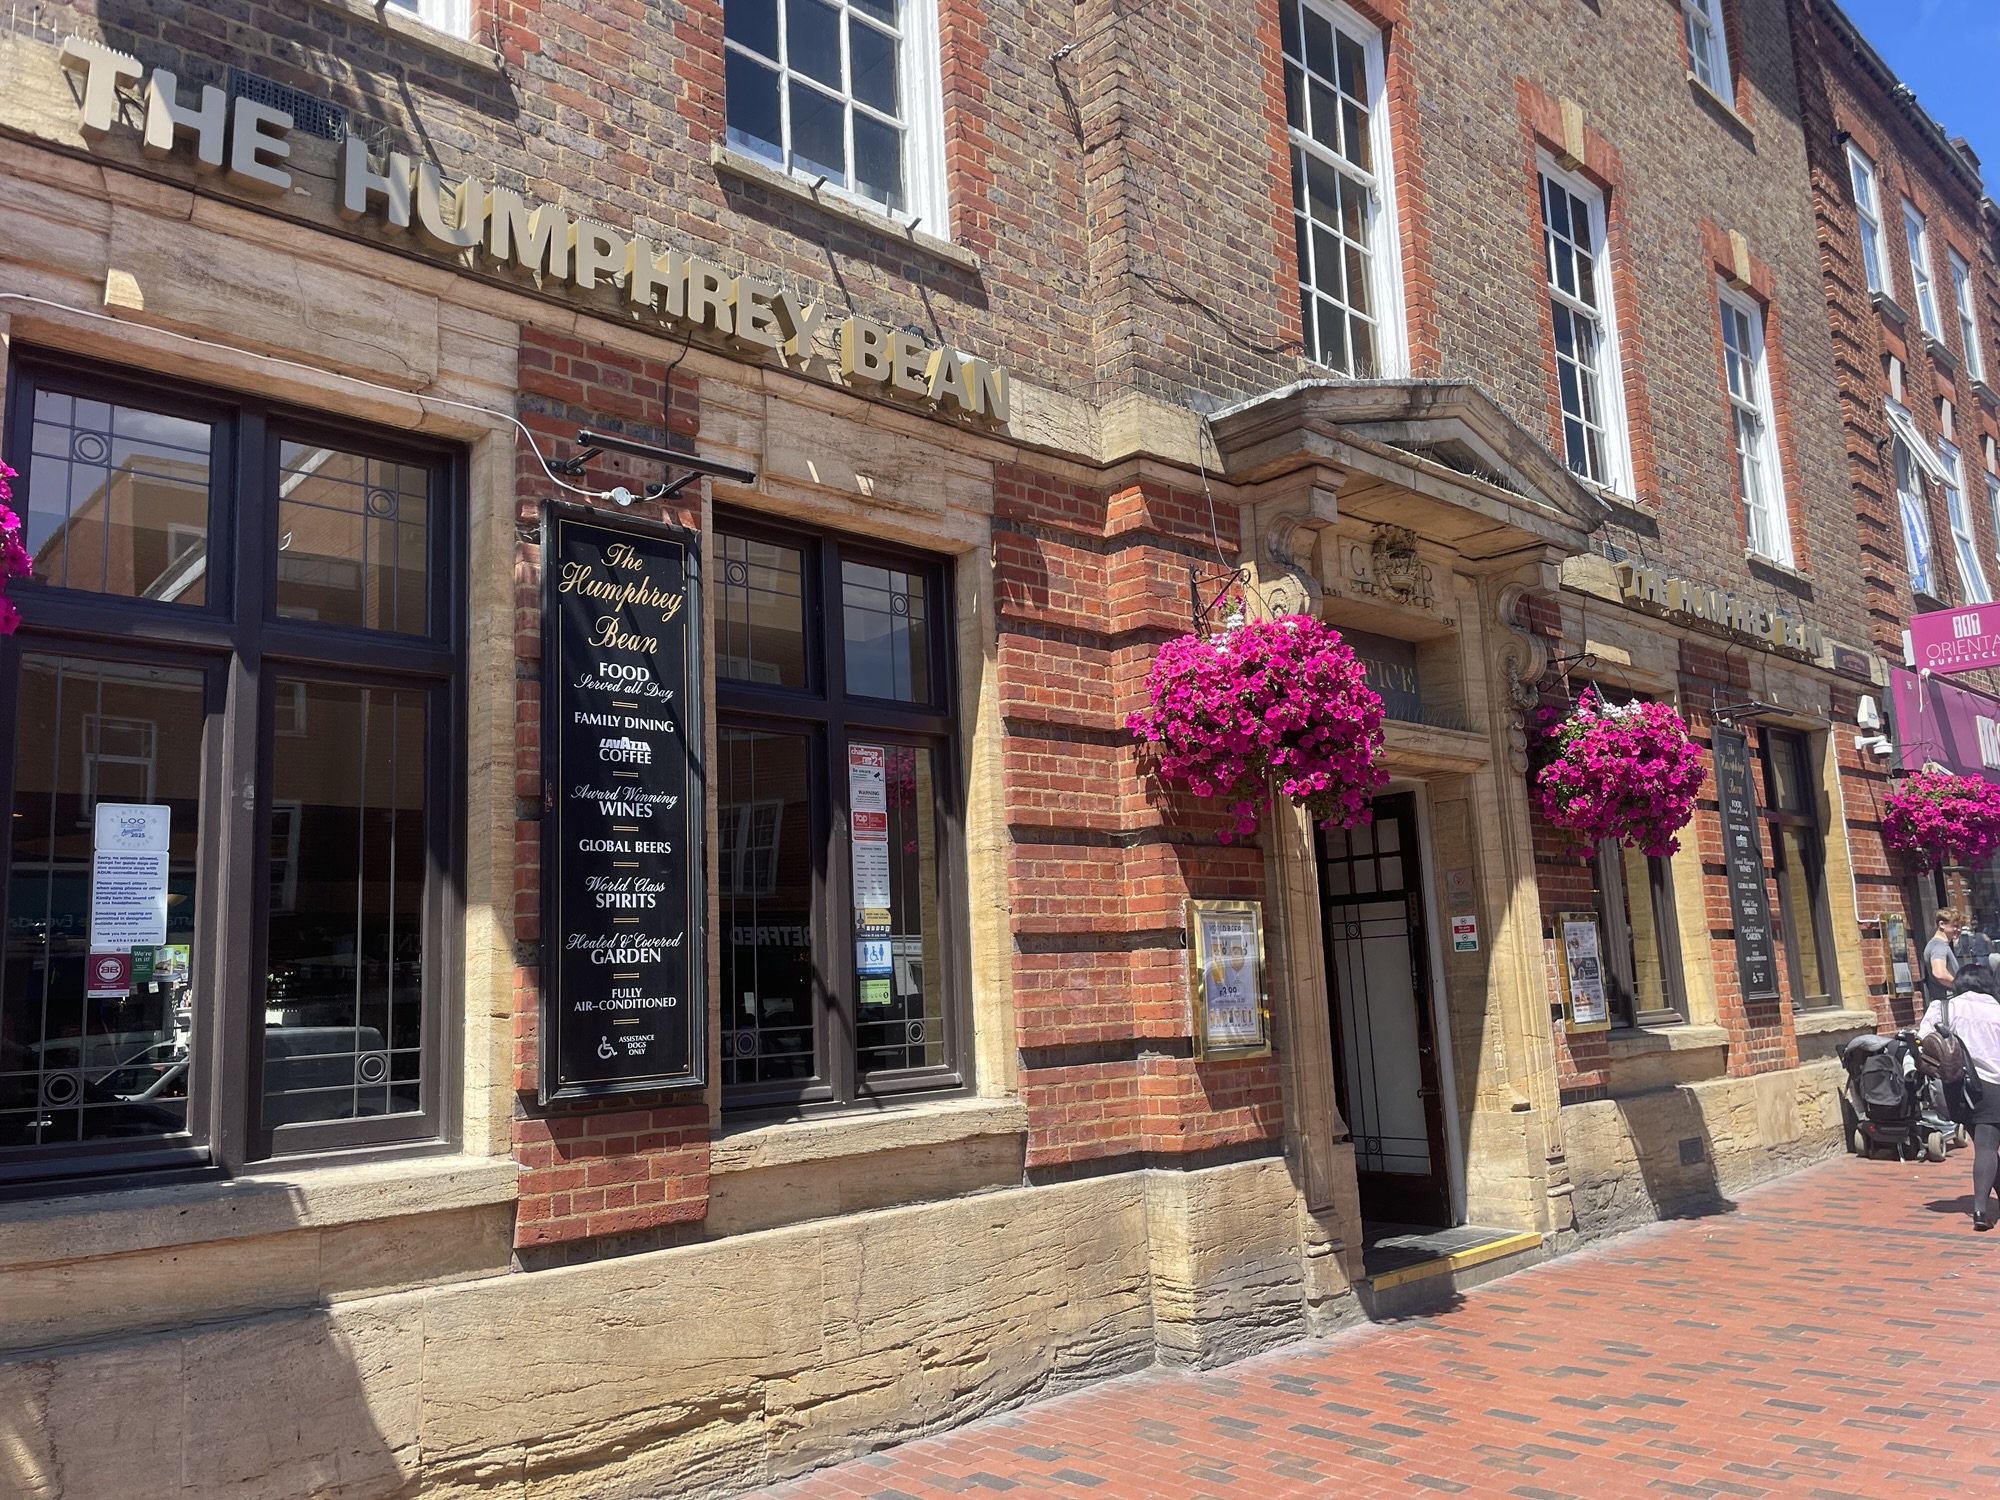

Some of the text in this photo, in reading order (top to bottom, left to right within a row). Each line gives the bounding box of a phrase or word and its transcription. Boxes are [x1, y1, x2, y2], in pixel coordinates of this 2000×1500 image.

[59, 34, 1010, 427] THE HUMPHREY BEAN
[601, 543, 642, 571] The
[558, 561, 682, 622] Humphrey
[1614, 560, 1823, 658] THE HUMPHREY BEAN
[588, 616, 657, 654] Bean
[599, 662, 649, 682] FOOD
[574, 673, 673, 703] Served all Day
[574, 711, 674, 732] FAMILY DINING
[600, 736, 650, 751] LAVAZZA
[600, 749, 651, 764] COFFEE
[872, 757, 882, 766] 21
[571, 783, 678, 809] Award Winning
[600, 801, 652, 818] WINES
[579, 838, 671, 854] GLOBAL BEERS
[585, 876, 665, 892] World Class
[596, 893, 656, 909] SPIRITS
[566, 931, 683, 950] Heated & Covered
[591, 948, 661, 965] GARDEN
[612, 987, 642, 998] FULLY
[574, 997, 677, 1012] AIR-CONDITIONED
[619, 1034, 655, 1043] ASSISTANCE
[627, 1042, 647, 1050] DOGS
[628, 1048, 646, 1056] ONLY
